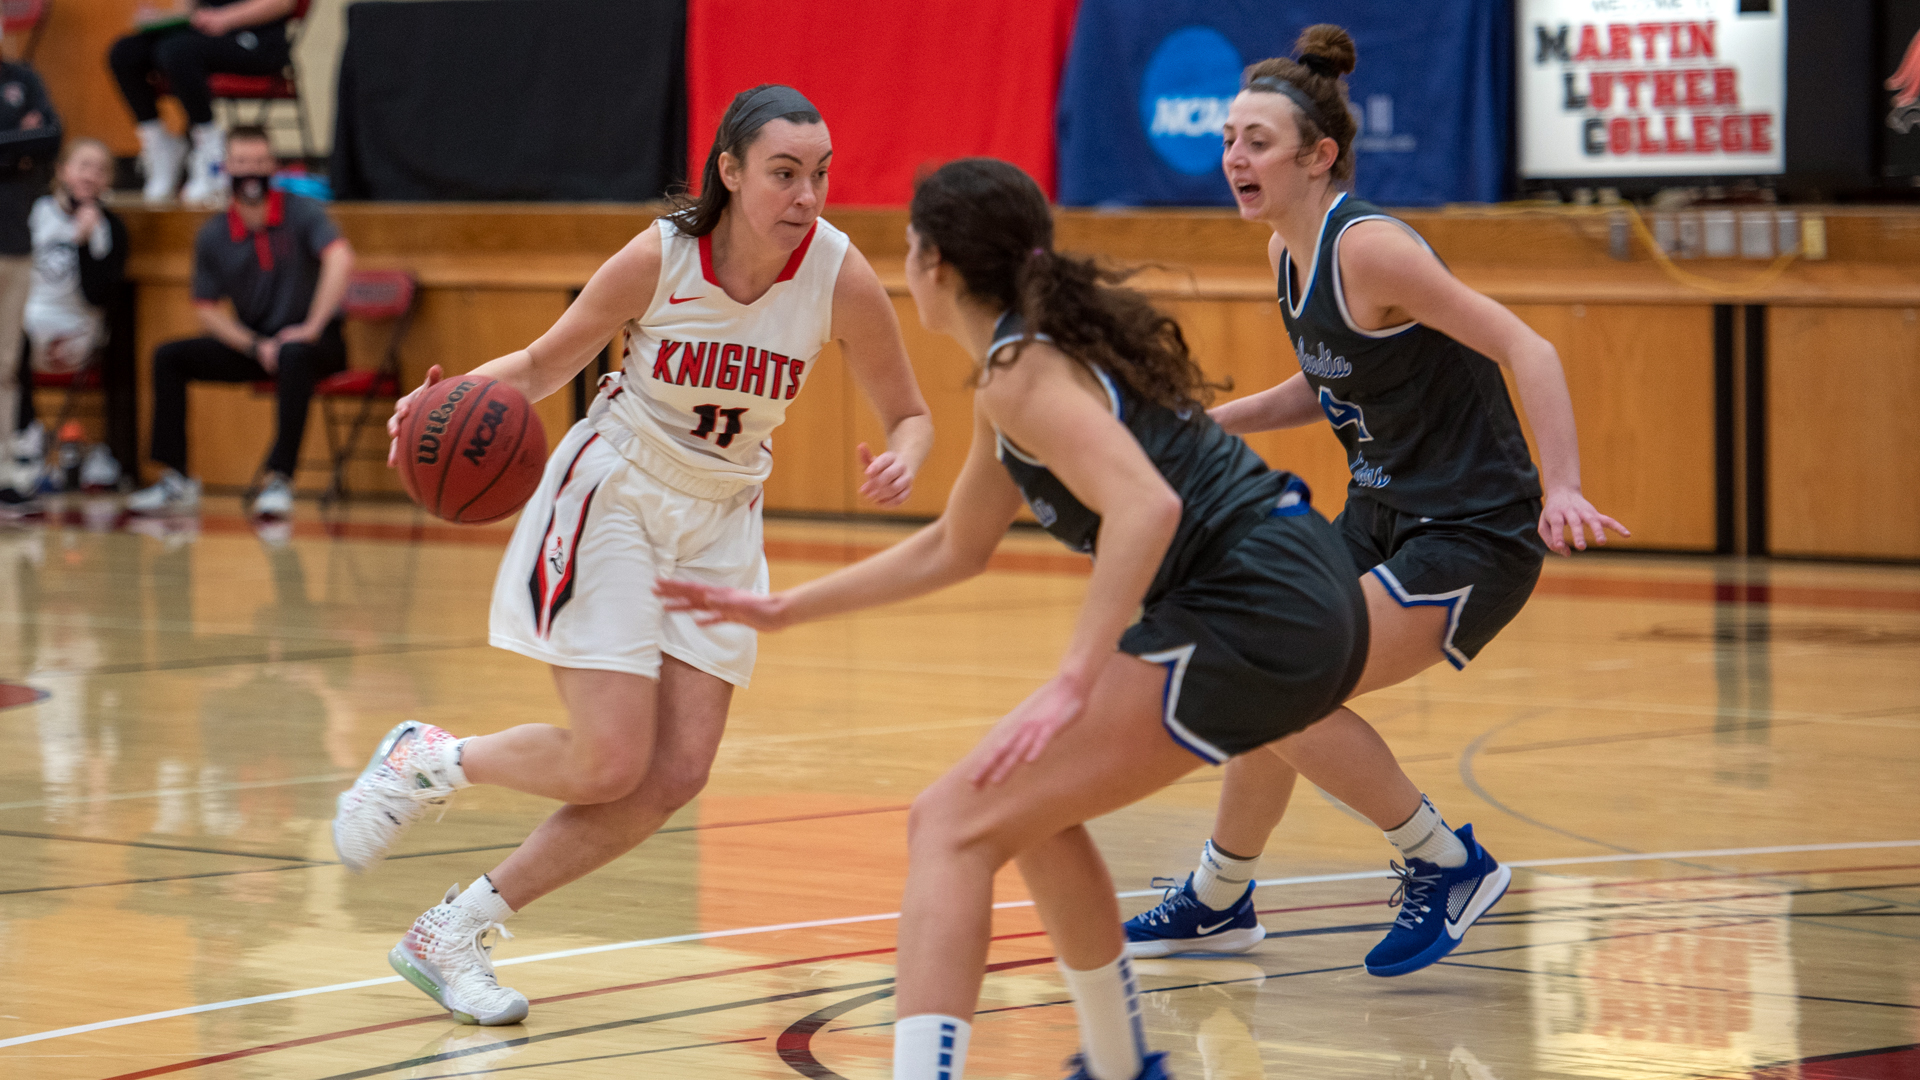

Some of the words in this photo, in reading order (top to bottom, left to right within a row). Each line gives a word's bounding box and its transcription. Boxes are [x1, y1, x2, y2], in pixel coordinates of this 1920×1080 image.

[1534, 20, 1716, 63] MARTIN
[1563, 68, 1738, 110] LUTHER
[1582, 113, 1773, 156] COLLEGE
[652, 339, 805, 400] KNIGHTS
[417, 380, 478, 465] Wilson
[462, 399, 508, 467] NCAA
[690, 403, 750, 449] 11
[1317, 384, 1375, 443] 4
